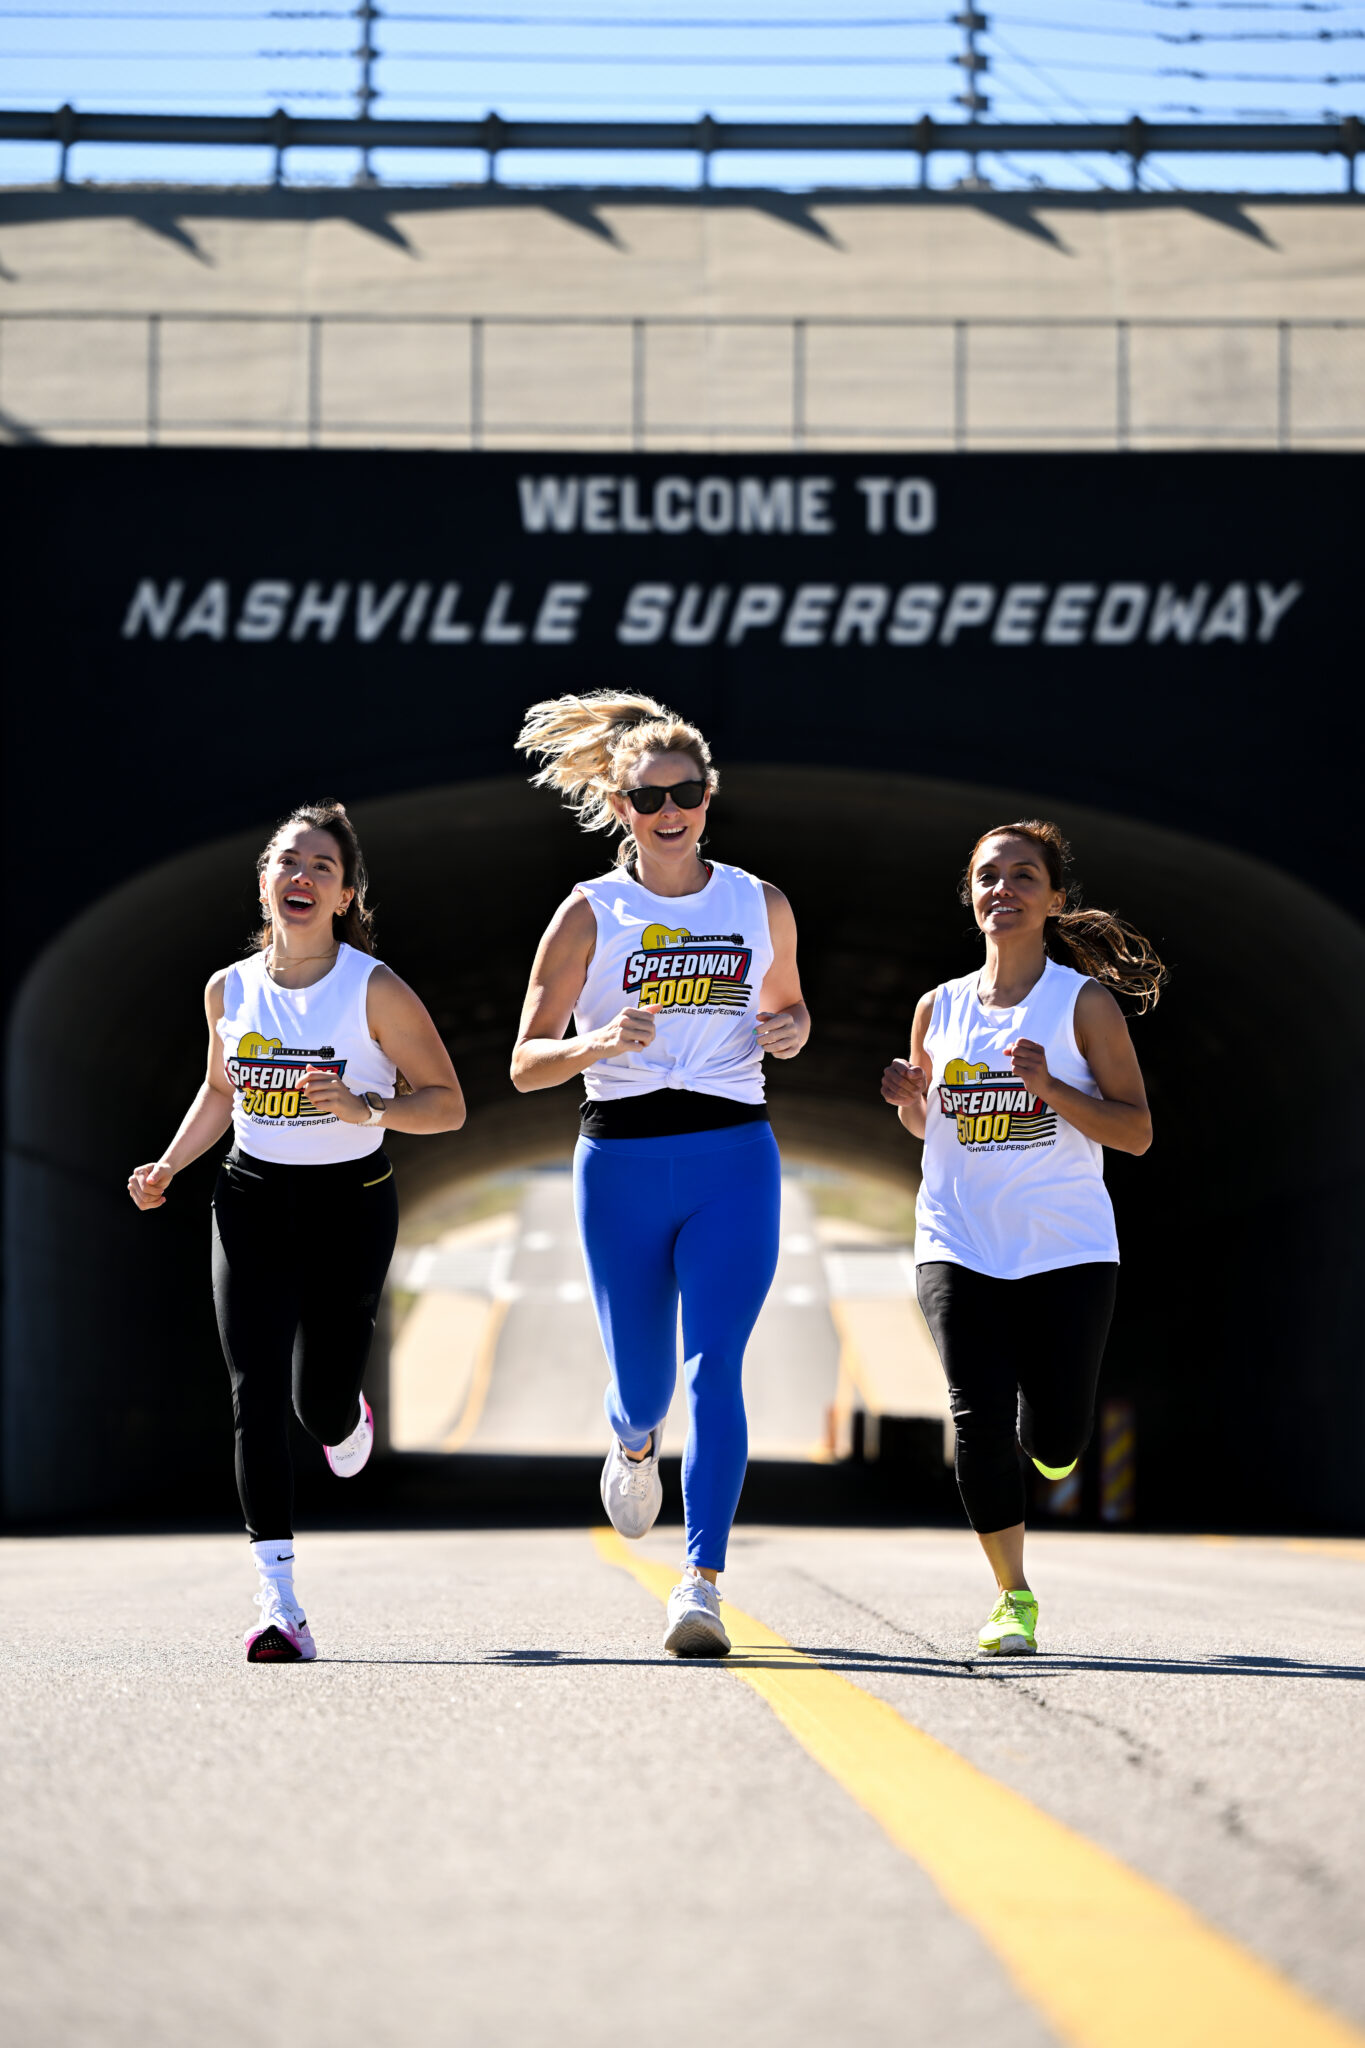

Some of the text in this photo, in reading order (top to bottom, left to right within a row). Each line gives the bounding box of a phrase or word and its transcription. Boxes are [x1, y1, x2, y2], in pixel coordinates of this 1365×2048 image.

[521, 478, 934, 532] WELCOME TO
[123, 582, 1301, 644] NASHVILLE SUPERSPEEDWAY
[627, 953, 743, 985] SPEEDWAY
[638, 977, 714, 1009] 5000
[228, 1059, 335, 1090] SPEEDW
[241, 1087, 302, 1119] 5000
[940, 1087, 1038, 1115] SPEEDWAY
[956, 1113, 1012, 1145] 5000
[996, 1138, 1056, 1151] SUPERSPEDWAY
